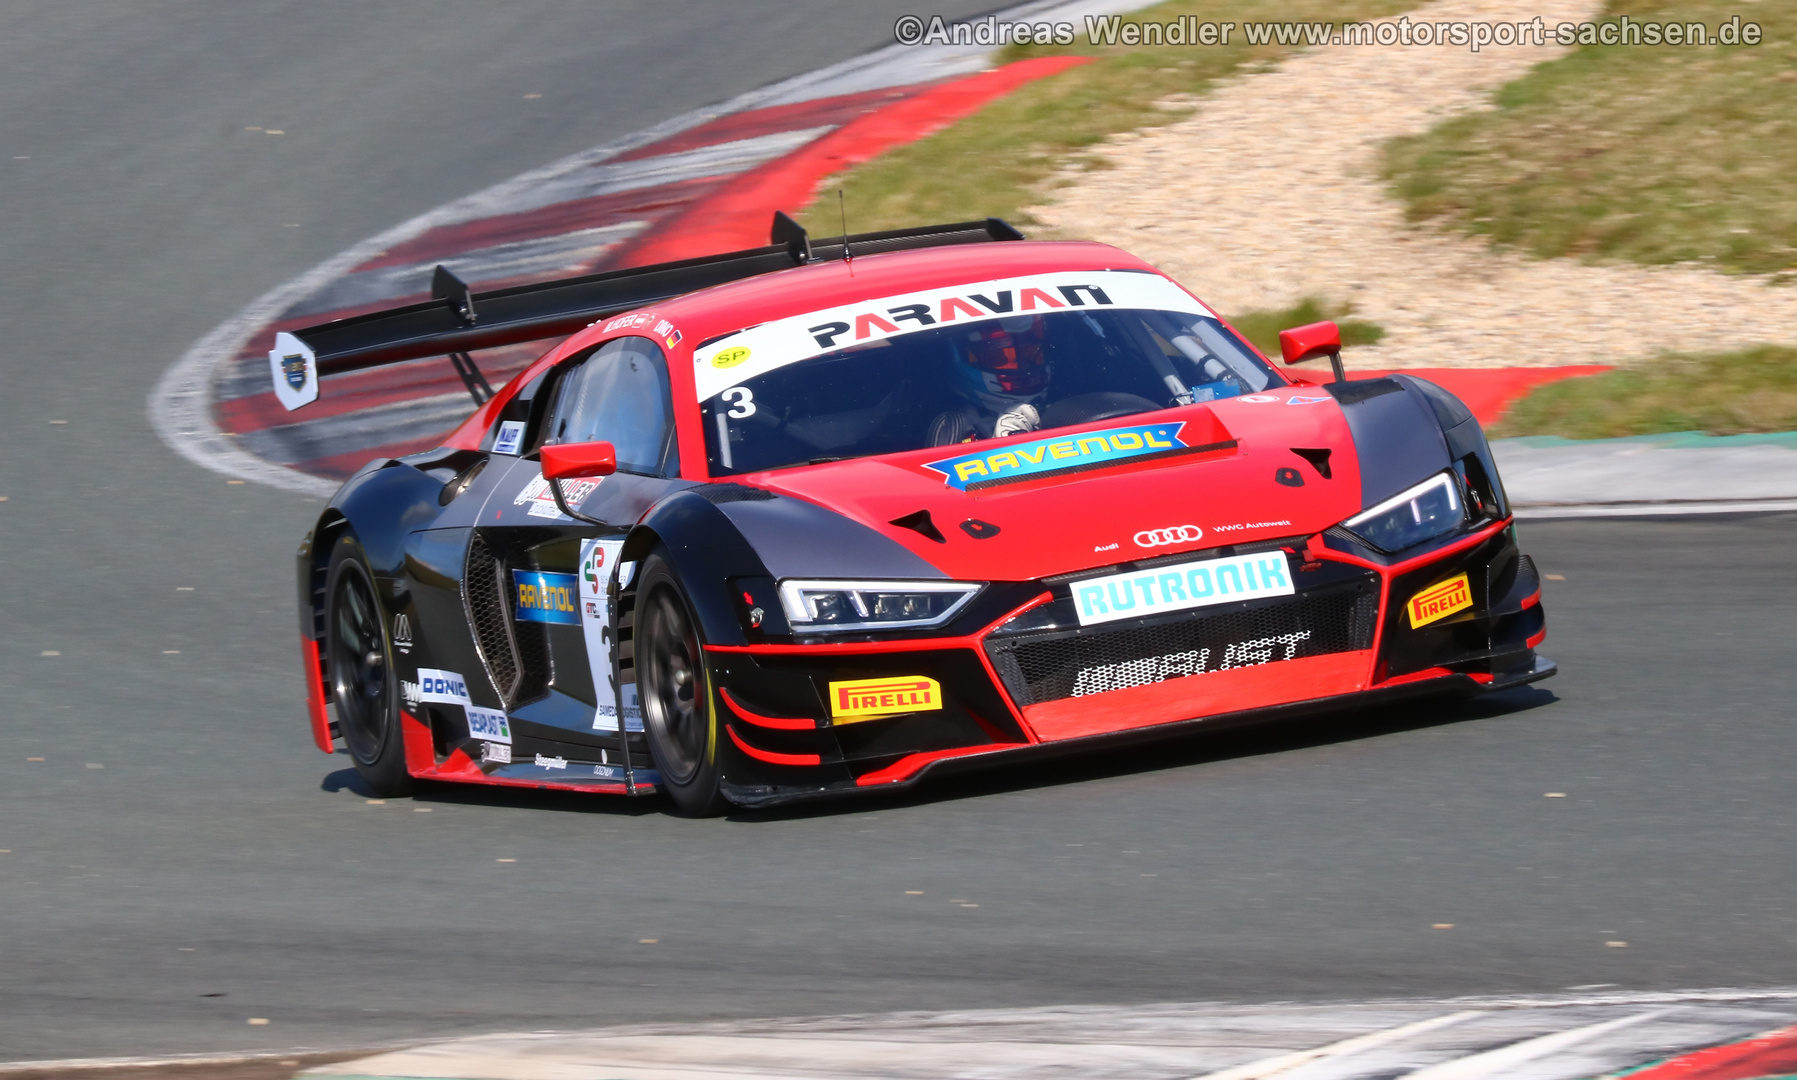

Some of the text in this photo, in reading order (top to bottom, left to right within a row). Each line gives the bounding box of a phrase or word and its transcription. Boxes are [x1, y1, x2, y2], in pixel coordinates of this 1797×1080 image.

[808, 284, 1114, 348] PARAVAN
[717, 350, 746, 364] SP
[721, 386, 757, 419] 3
[954, 430, 1172, 481] RAVENOL
[1213, 519, 1291, 533] WWG Autowelt
[1094, 542, 1119, 553] Audi
[519, 583, 574, 612] RAVENOL
[1078, 558, 1288, 617] RUTRONIK
[1412, 579, 1467, 621] PIRELLI
[423, 677, 467, 697] DONIC
[838, 681, 931, 710] PIRELLI
